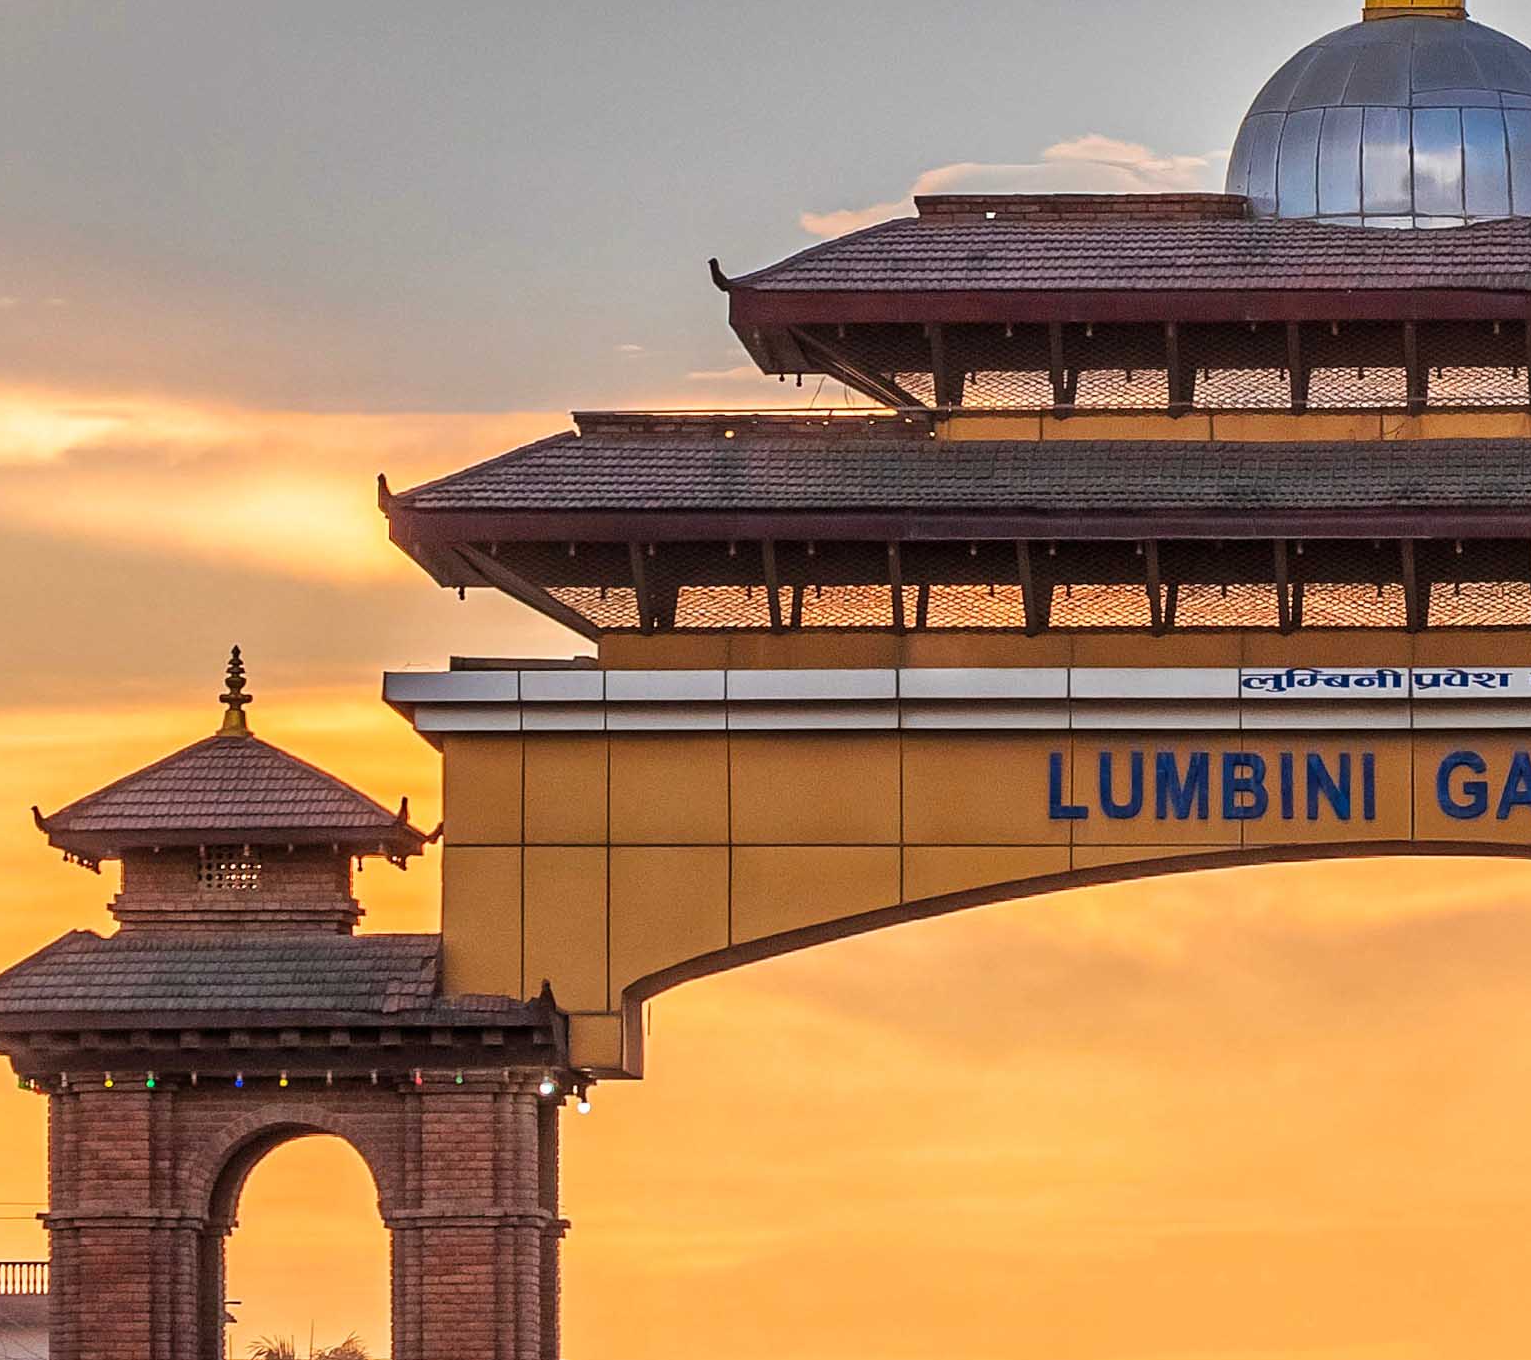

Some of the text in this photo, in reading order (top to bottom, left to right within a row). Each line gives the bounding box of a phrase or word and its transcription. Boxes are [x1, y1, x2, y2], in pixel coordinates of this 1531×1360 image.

[1241, 667, 1405, 693] लुम्बिनी
[1412, 668, 1514, 691] प्रवेश
[1048, 750, 1376, 822] LUMBINI
